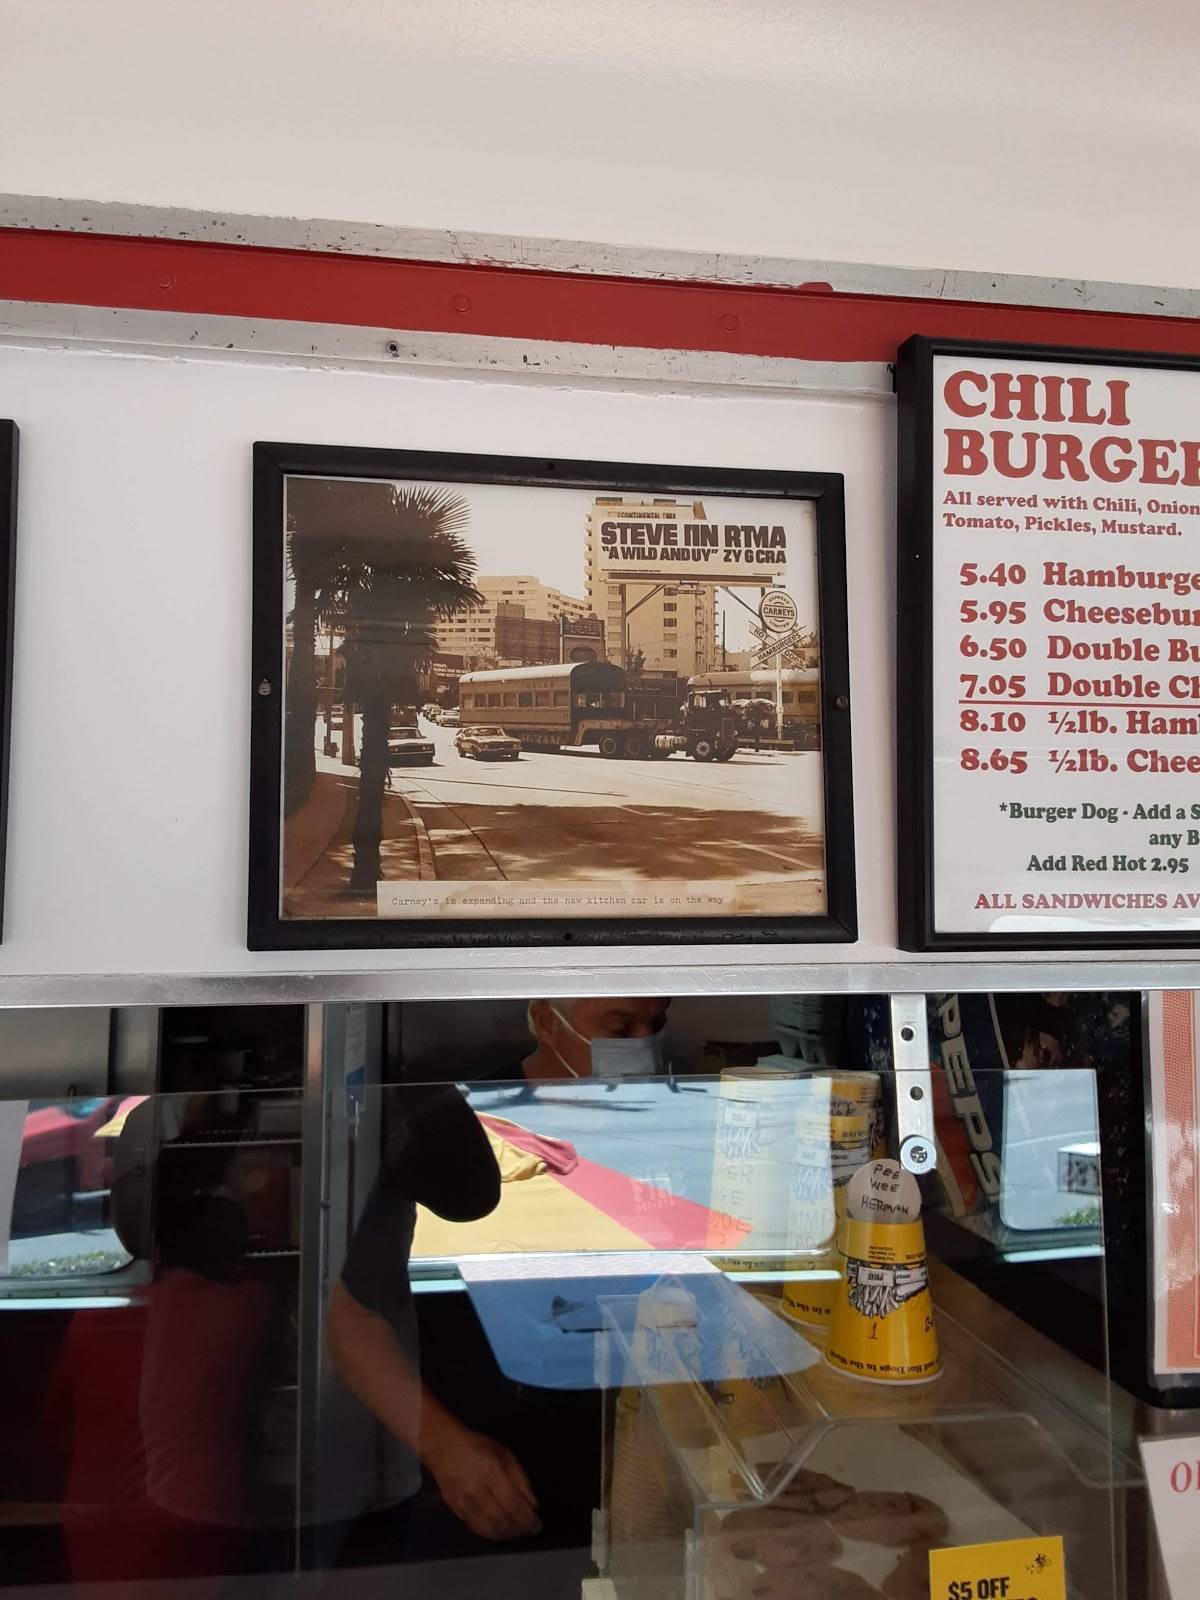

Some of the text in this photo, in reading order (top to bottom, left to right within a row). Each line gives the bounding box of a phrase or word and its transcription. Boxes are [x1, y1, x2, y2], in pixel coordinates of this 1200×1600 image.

[943, 370, 1131, 427] CHILI
[942, 490, 972, 506] All
[976, 494, 1038, 509] served
[1042, 496, 1089, 512] with
[1092, 497, 1143, 516] Chili,
[601, 522, 678, 546] STEVE
[724, 525, 787, 549] RTMA
[942, 512, 1183, 537] Tomato, Pickles, Mustard.
[621, 547, 659, 560] WILD
[959, 563, 1027, 587] 5.40
[959, 600, 1027, 625] 5.95
[753, 628, 768, 641] HOT
[757, 631, 801, 662] HAMBURGERS
[959, 634, 1027, 661] 6.50
[1046, 635, 1160, 662] Double
[959, 674, 1026, 699] 7.05
[1047, 671, 1161, 699] Double
[959, 709, 1026, 733] 8.10
[1125, 710, 1200, 736] Ham
[960, 748, 1028, 775] 8.65
[1081, 802, 1119, 824] Dog
[1132, 803, 1172, 820] Add
[1175, 807, 1186, 820] a
[1148, 833, 1183, 849] any
[1026, 854, 1190, 874] Add Red Hot 2.95
[391, 897, 439, 907] Carney's
[445, 897, 456, 905] is
[462, 897, 514, 907] expanding
[519, 897, 536, 905] and
[587, 896, 627, 905] kitchen
[631, 897, 648, 905] car
[654, 896, 664, 905] is
[670, 897, 682, 905] on
[686, 896, 702, 904] the
[707, 897, 724, 906] way
[974, 893, 1017, 910] ALL
[1021, 893, 1168, 910] SANDWICHES
[873, 1163, 900, 1180] PEE
[861, 1194, 909, 1215] HERMAN
[947, 1576, 1010, 1600] $5 OFF
